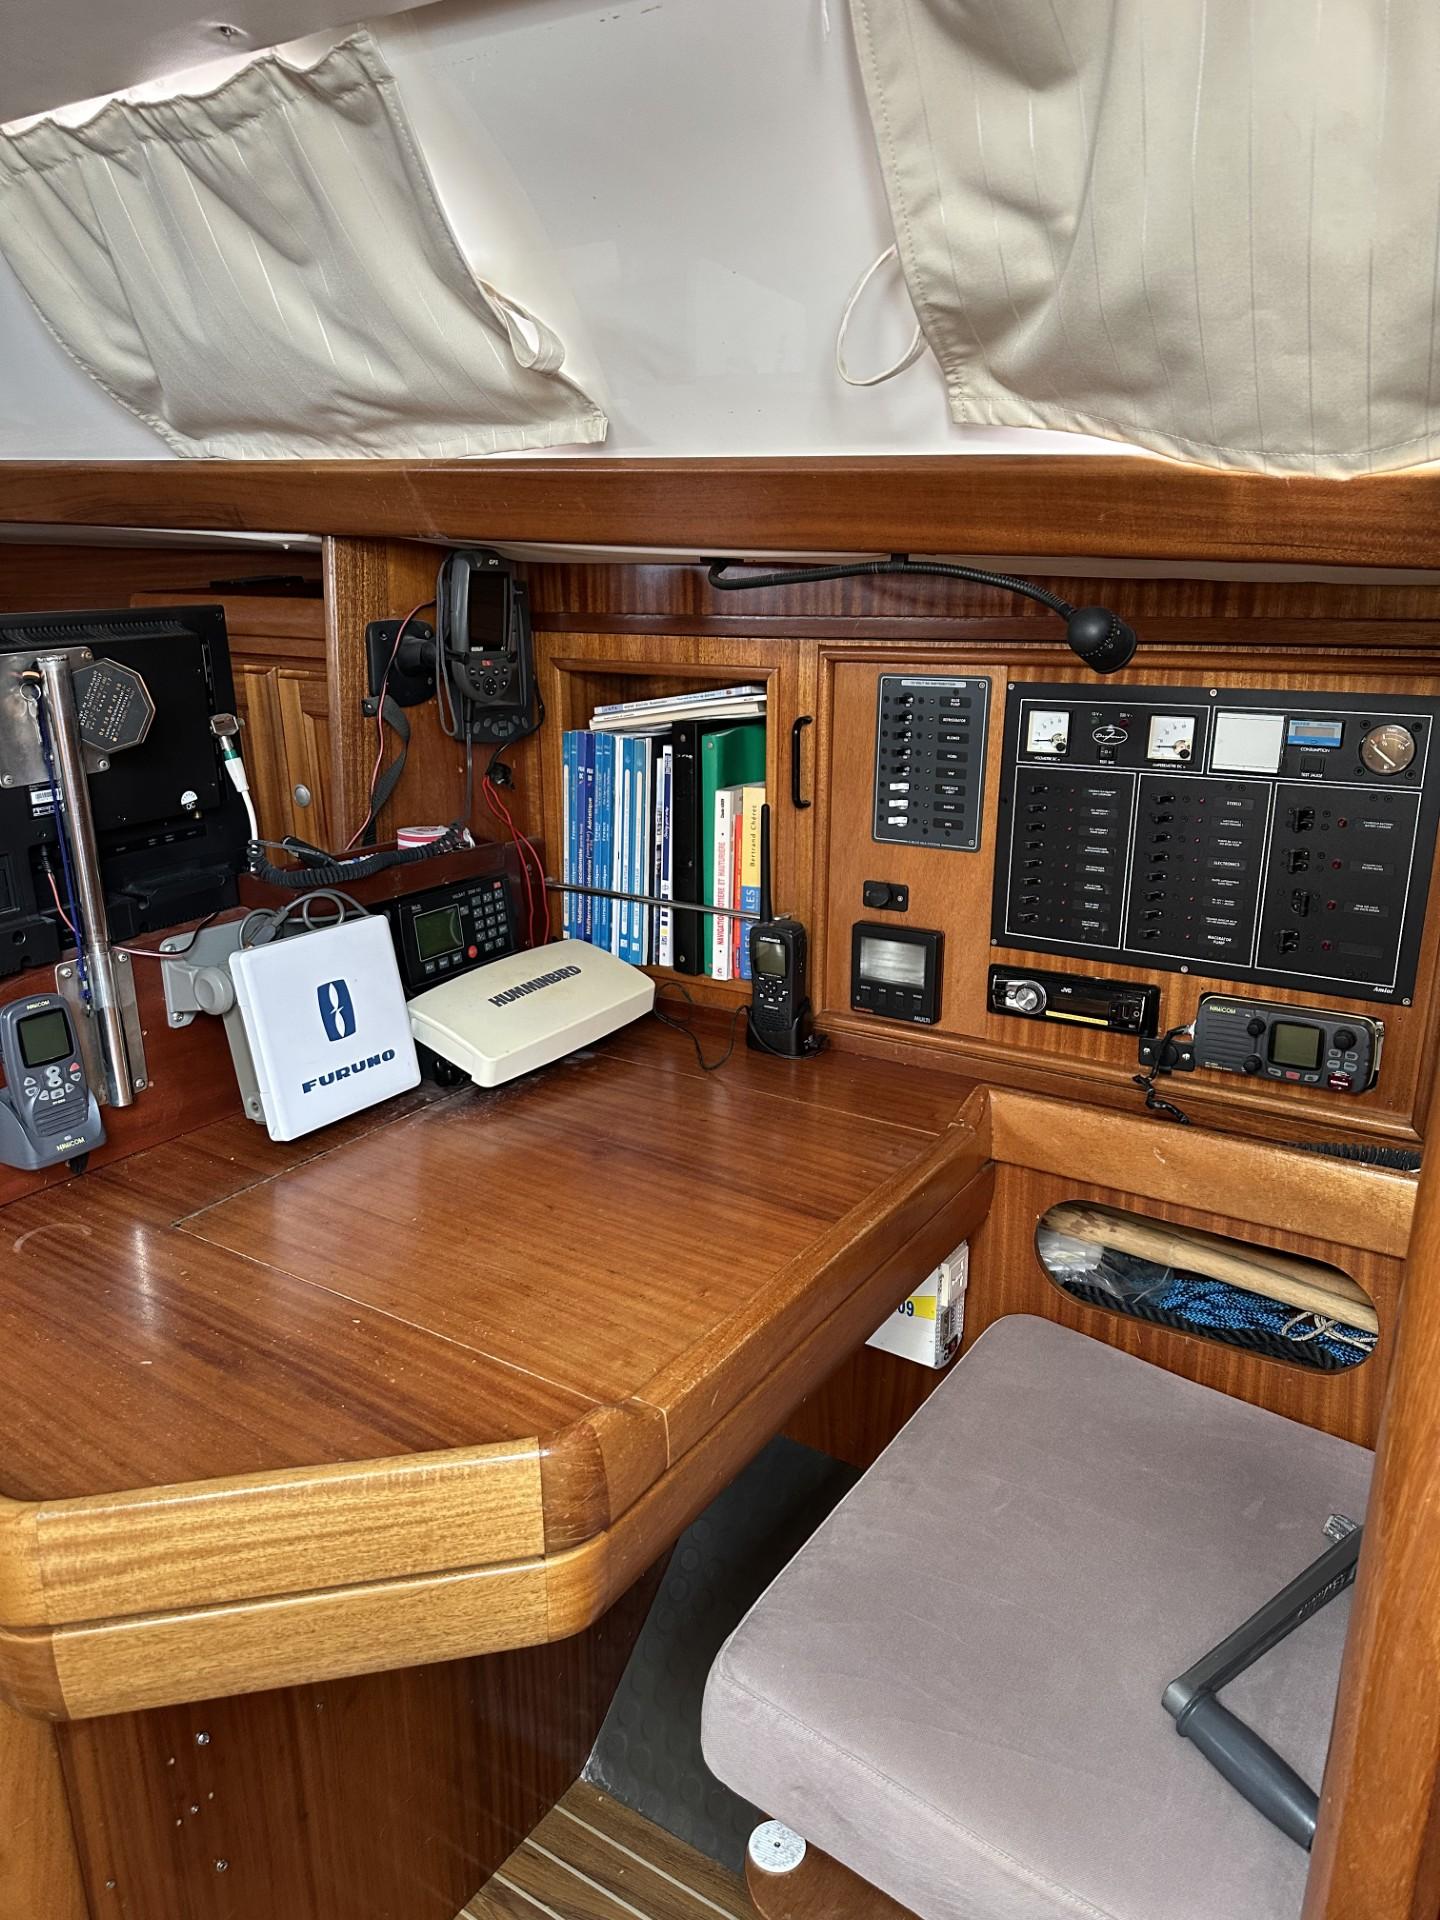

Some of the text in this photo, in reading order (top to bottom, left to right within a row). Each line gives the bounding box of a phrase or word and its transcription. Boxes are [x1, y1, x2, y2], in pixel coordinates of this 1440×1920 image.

[749, 833, 757, 867] Bertrand
[487, 964, 583, 1008] HUMMINBIRD
[1060, 986, 1072, 994] JVC
[913, 1015, 931, 1024] MULTI
[302, 1047, 397, 1094] FURUNO
